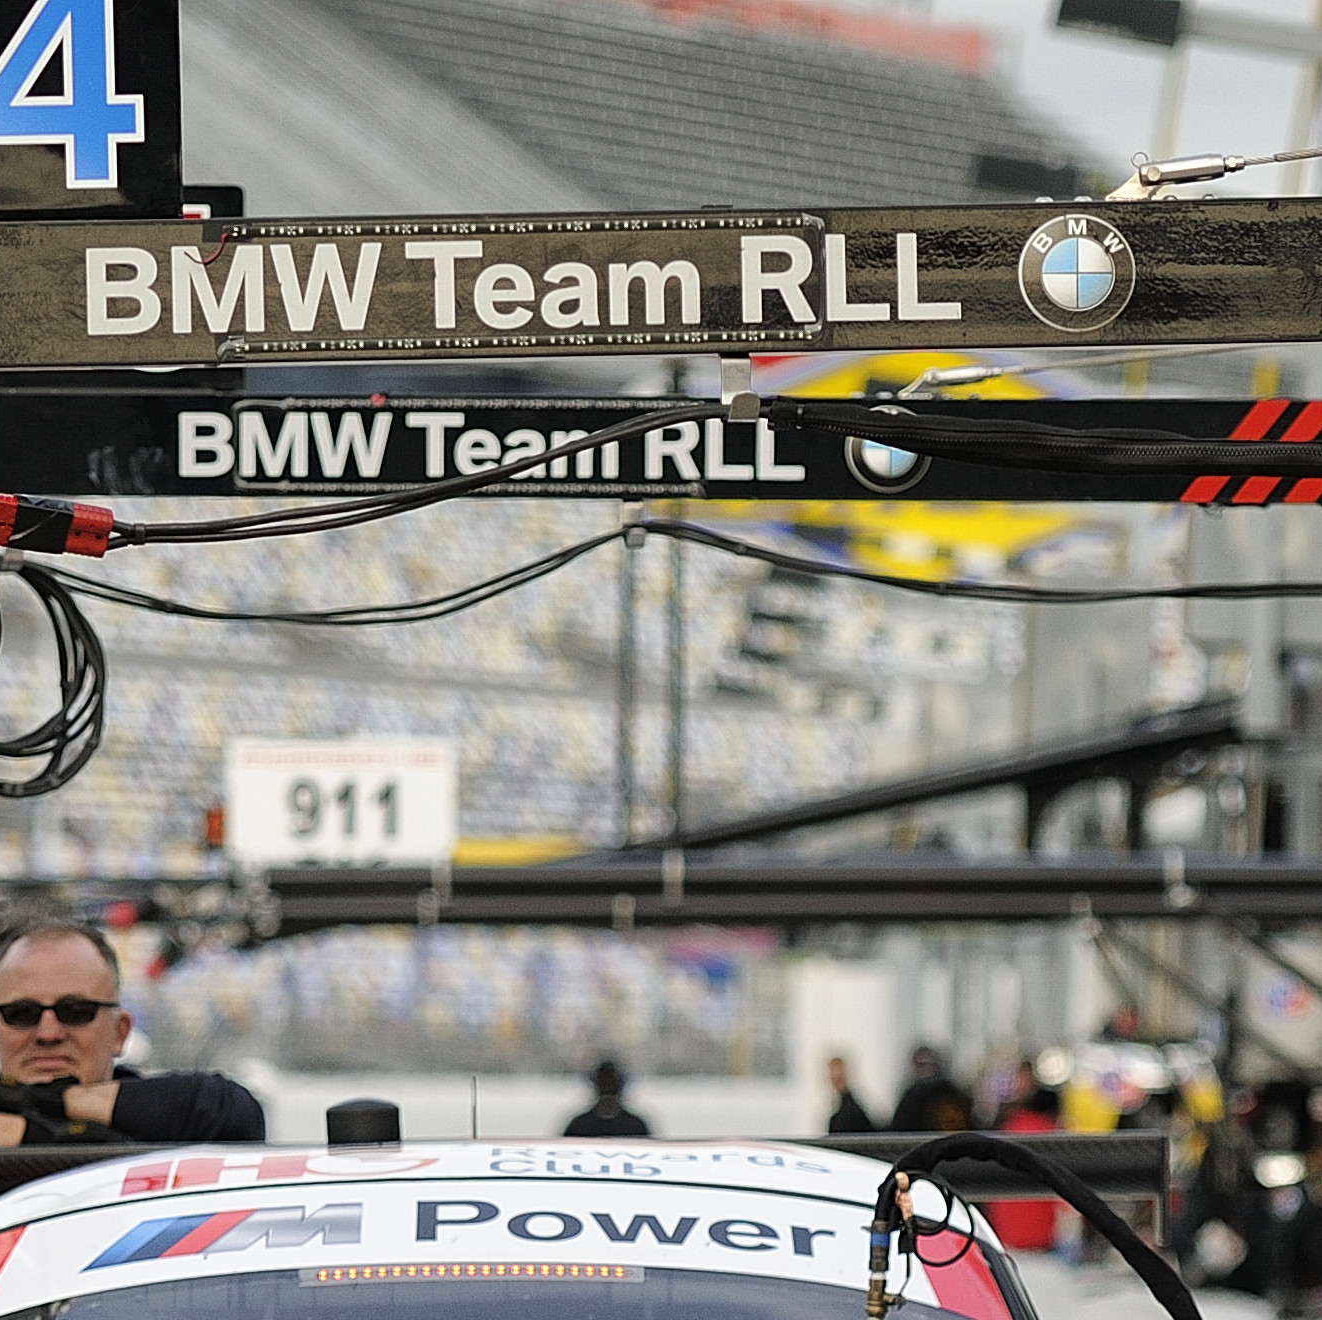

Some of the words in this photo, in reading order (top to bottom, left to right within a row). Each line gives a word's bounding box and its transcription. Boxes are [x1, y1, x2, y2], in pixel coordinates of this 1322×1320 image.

[85, 242, 383, 337] BMW
[405, 236, 702, 331] Team
[738, 232, 963, 326] RLL
[177, 411, 392, 480] BMW
[406, 412, 621, 481] Team
[645, 416, 806, 482] RLL
[287, 777, 401, 840] 911
[489, 1158, 663, 1178] Club
[415, 1199, 837, 1258] Power
